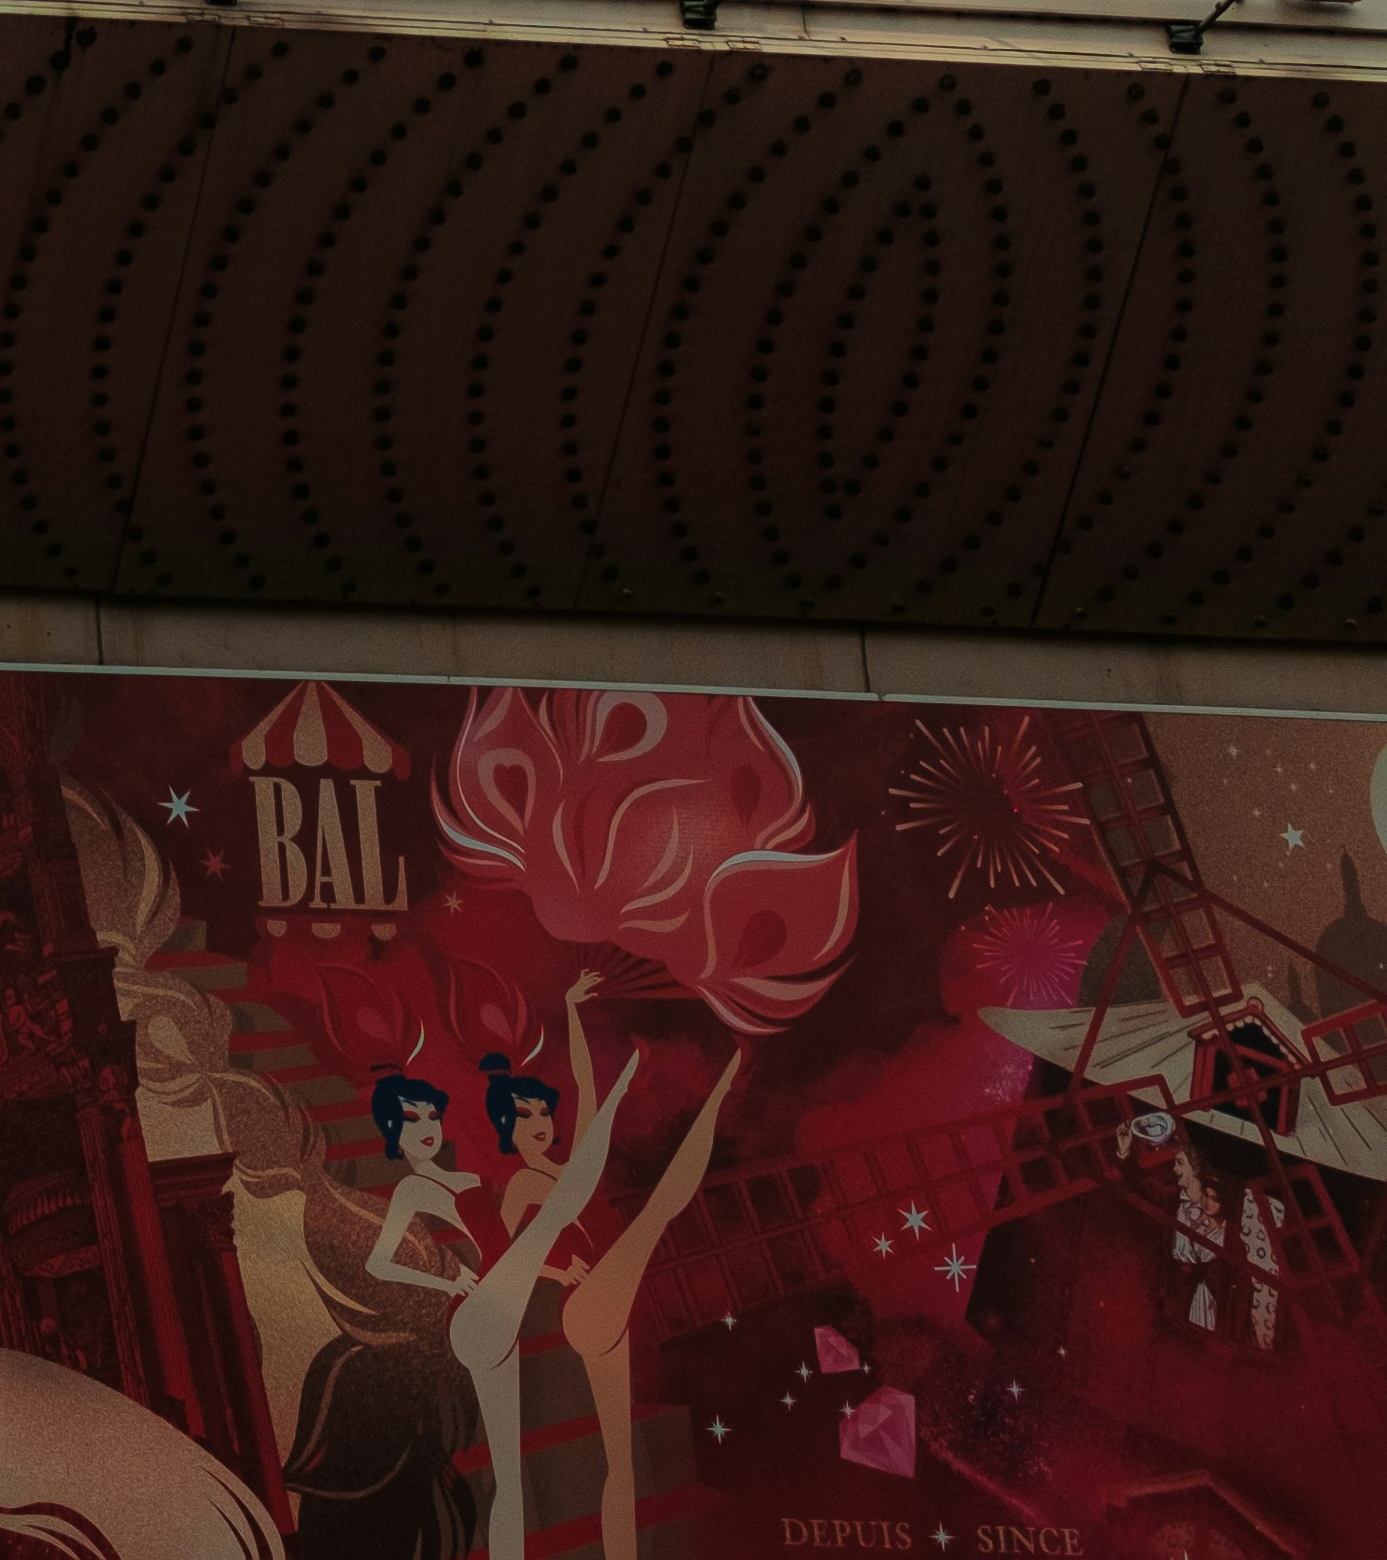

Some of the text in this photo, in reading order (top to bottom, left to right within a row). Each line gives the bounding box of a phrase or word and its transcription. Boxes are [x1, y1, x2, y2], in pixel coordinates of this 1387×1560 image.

[249, 775, 409, 912] BAL
[780, 1518, 1084, 1557] DEPUIS SINCE
